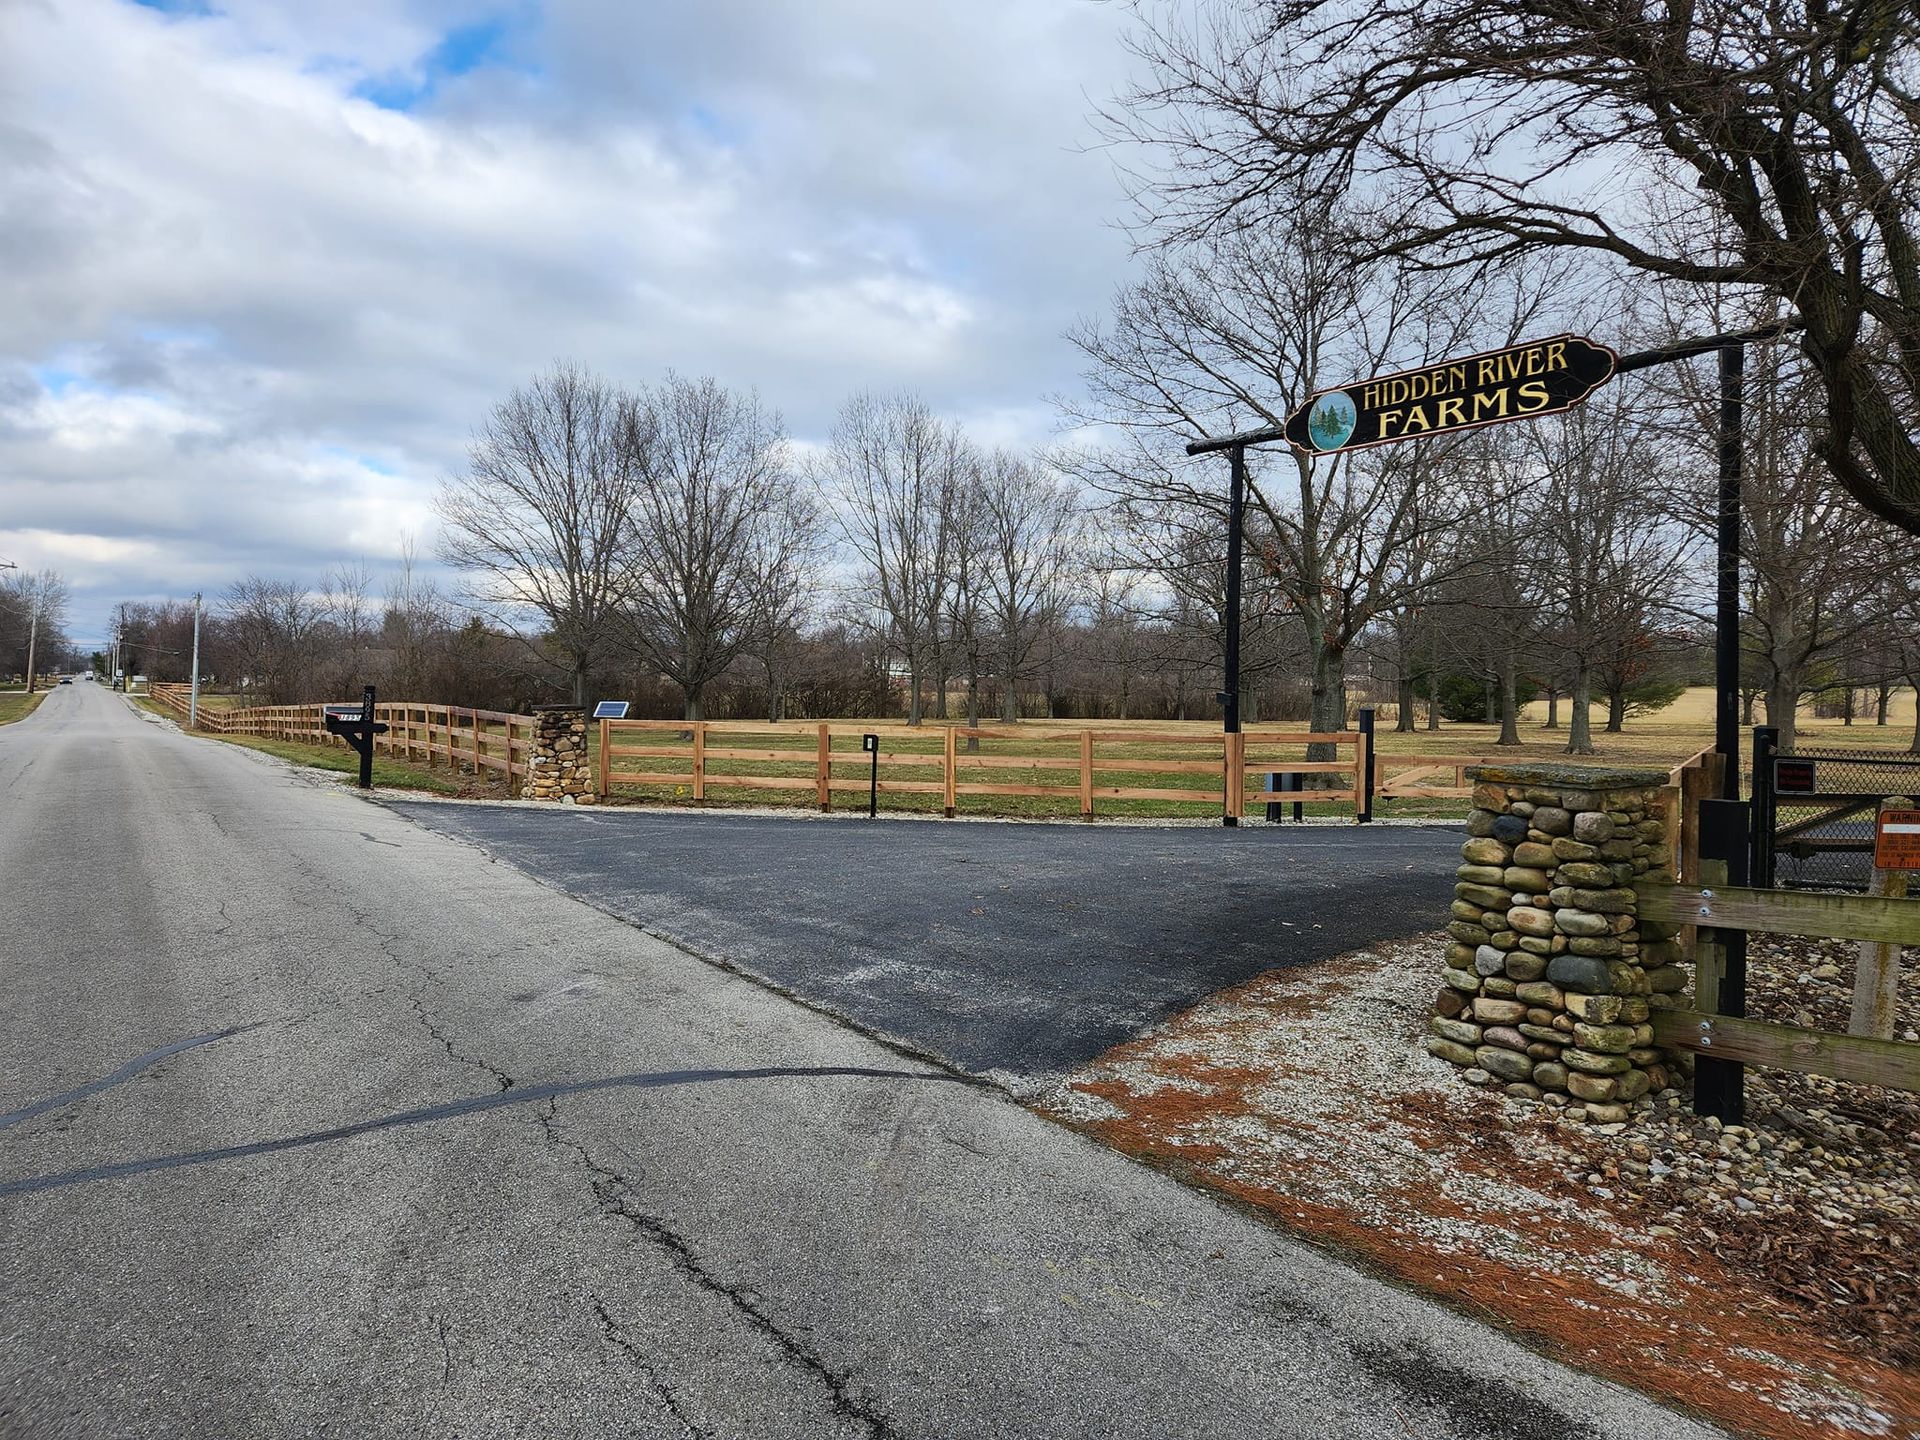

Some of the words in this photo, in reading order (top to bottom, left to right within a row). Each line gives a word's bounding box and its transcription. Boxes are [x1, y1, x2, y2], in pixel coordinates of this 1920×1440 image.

[1363, 365, 1467, 410] HIDDEN
[1477, 342, 1569, 387] RIVER
[1377, 380, 1550, 439] FARMS
